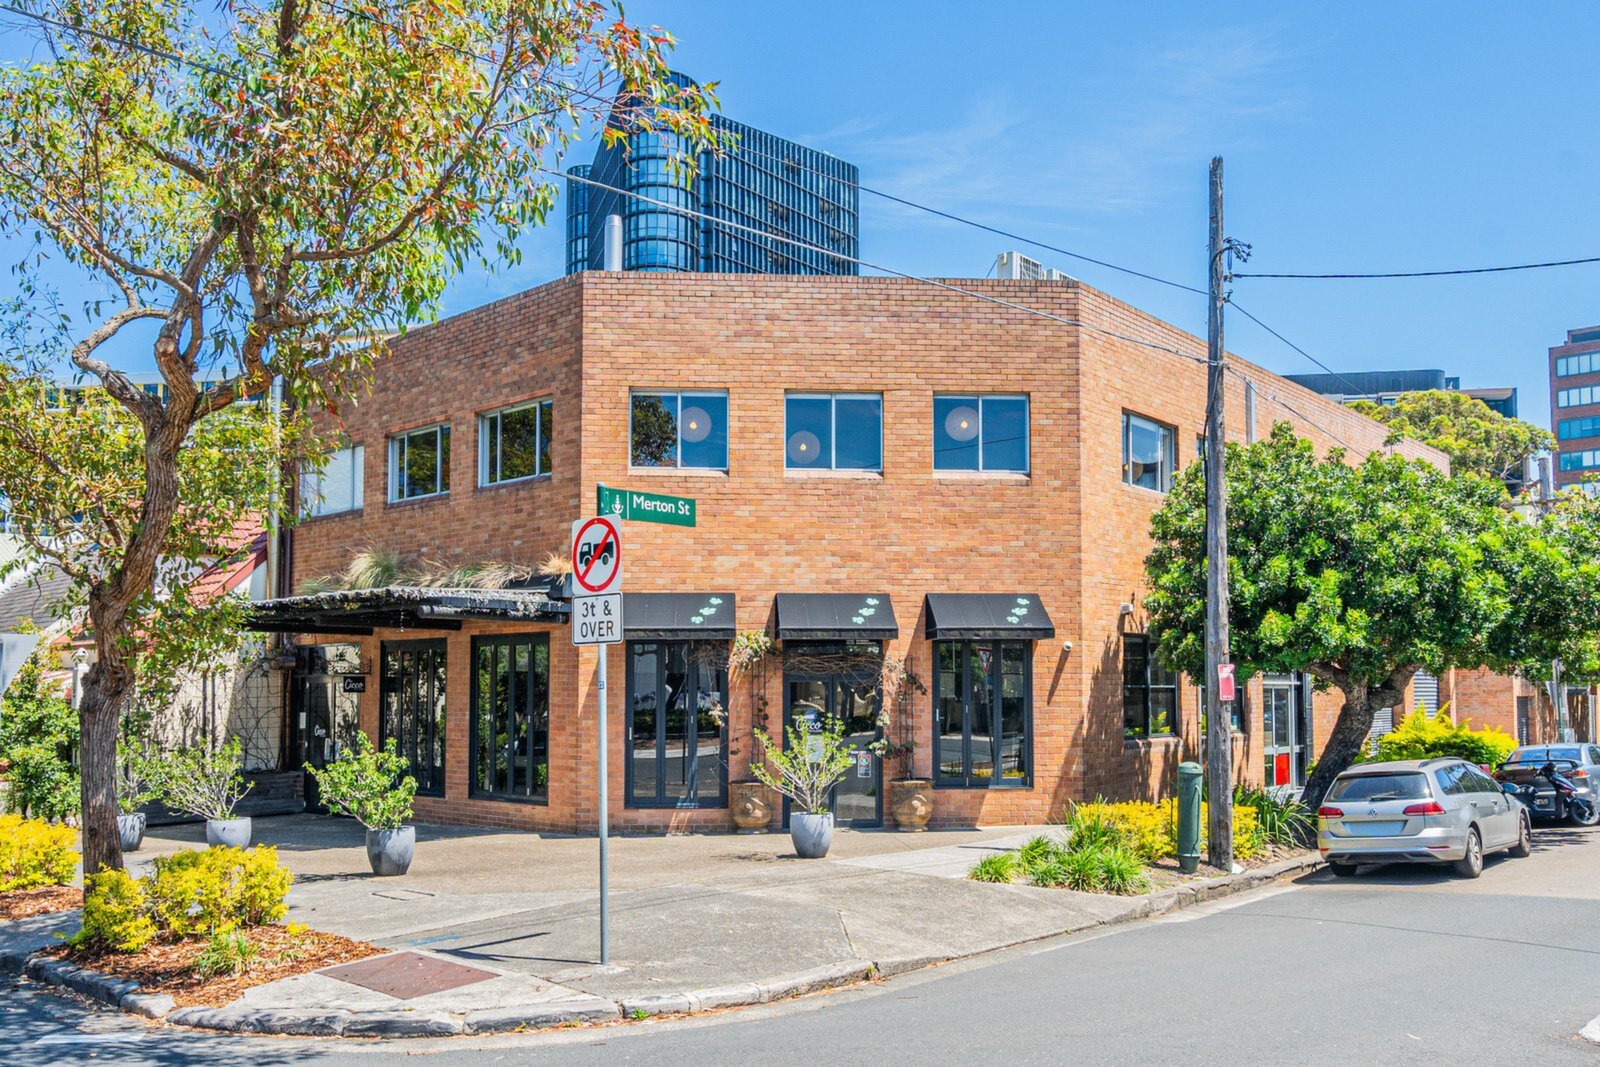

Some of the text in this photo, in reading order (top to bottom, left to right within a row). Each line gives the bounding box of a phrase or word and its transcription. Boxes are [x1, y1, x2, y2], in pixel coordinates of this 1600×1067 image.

[633, 495, 690, 515] Merton St
[582, 600, 612, 618] 3t &
[580, 621, 614, 638] OVER
